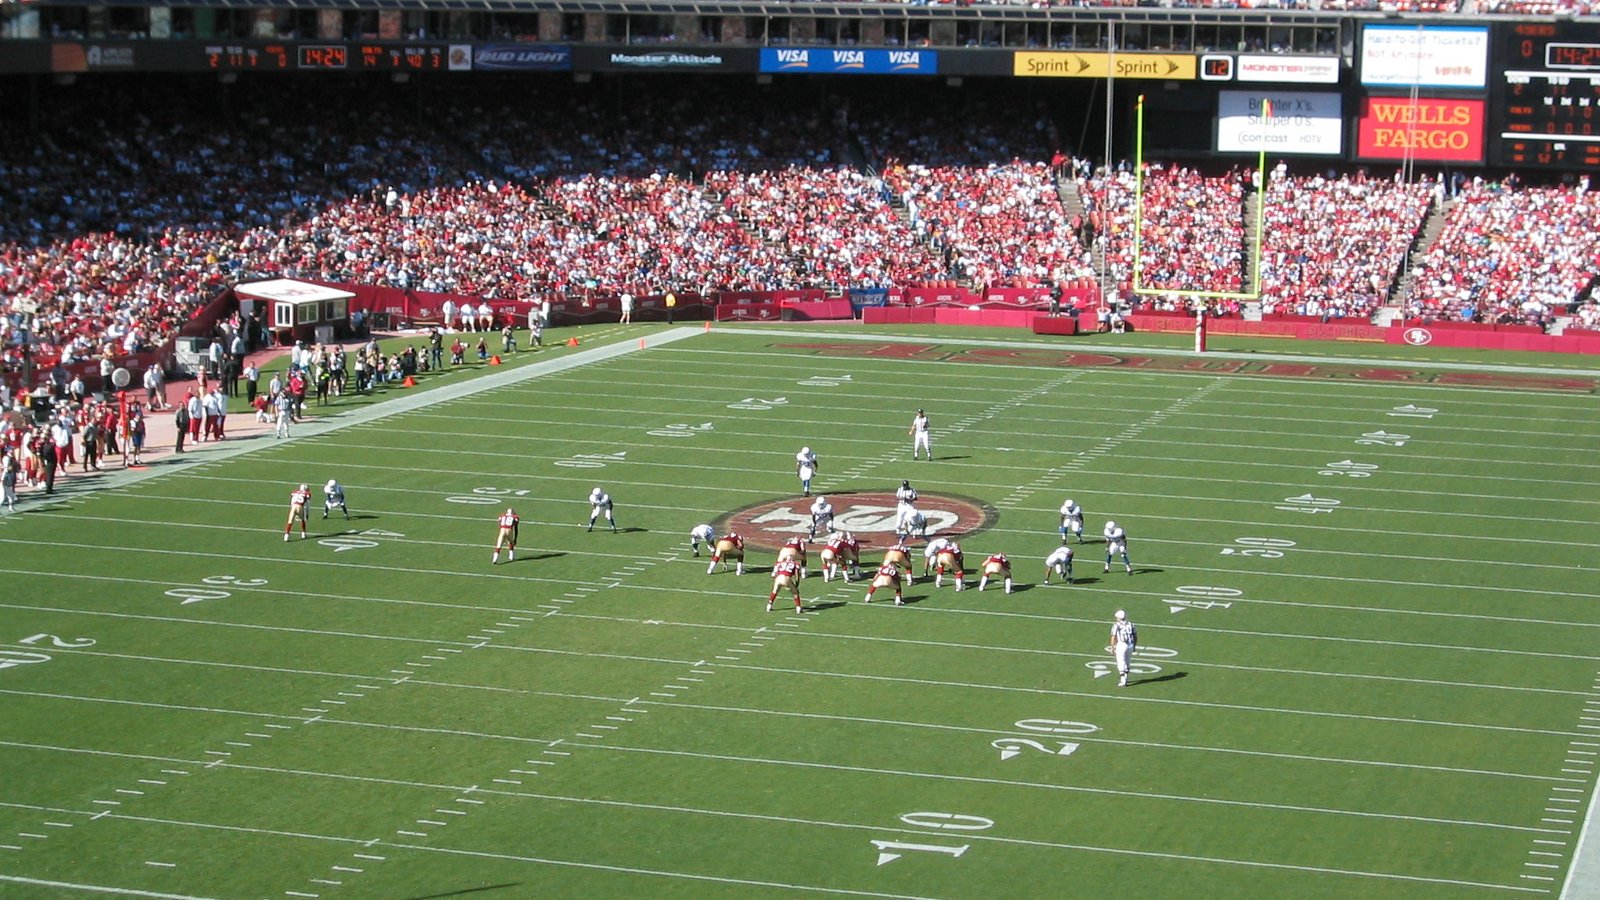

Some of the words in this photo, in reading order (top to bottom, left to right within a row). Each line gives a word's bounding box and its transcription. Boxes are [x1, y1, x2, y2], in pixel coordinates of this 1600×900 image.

[517, 52, 568, 62] LIGHT
[611, 53, 665, 63] Monster
[668, 54, 722, 64] Attitude
[777, 49, 808, 62] VISA
[833, 50, 864, 62] VISA
[889, 51, 920, 63] VISA
[1027, 58, 1069, 75] Sprint
[1116, 59, 1158, 76] Sprint
[1211, 61, 1229, 75] 12
[1243, 64, 1303, 72] MONSTER
[1372, 104, 1472, 126] WELLS
[1373, 128, 1470, 150] FARGO
[1354, 433, 1411, 446] 20
[1318, 462, 1379, 478] 30
[445, 486, 531, 505] 50
[1274, 497, 1341, 514] 40
[500, 516, 514, 526] 18
[1219, 537, 1296, 558] 50
[778, 563, 796, 573] 32
[164, 575, 268, 600] 30
[1162, 586, 1243, 610] 40
[1085, 646, 1179, 674] 30
[991, 718, 1099, 756] 20
[870, 811, 995, 858] 10
